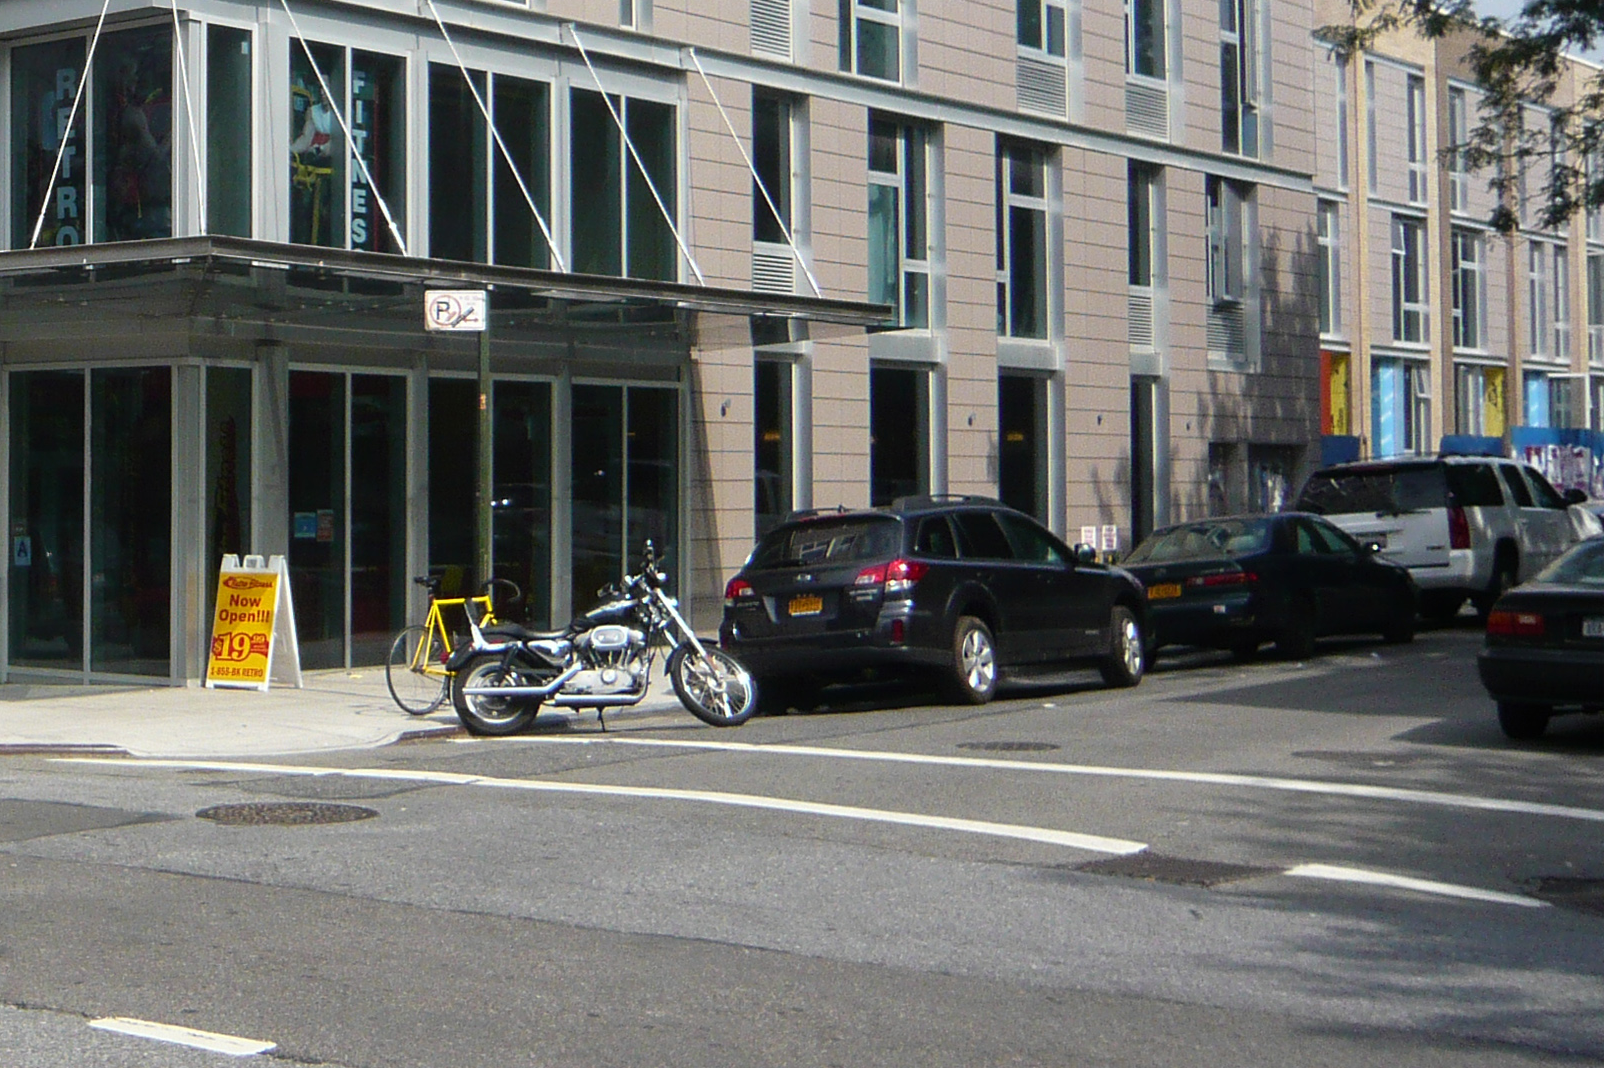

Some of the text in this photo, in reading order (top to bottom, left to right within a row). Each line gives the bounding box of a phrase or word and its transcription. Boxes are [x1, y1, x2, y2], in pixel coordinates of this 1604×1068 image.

[56, 68, 77, 245] RETRO
[351, 71, 367, 251] FITNES
[229, 594, 261, 607] Now
[219, 609, 270, 624] Open!!!
[242, 668, 264, 678] RETRO
